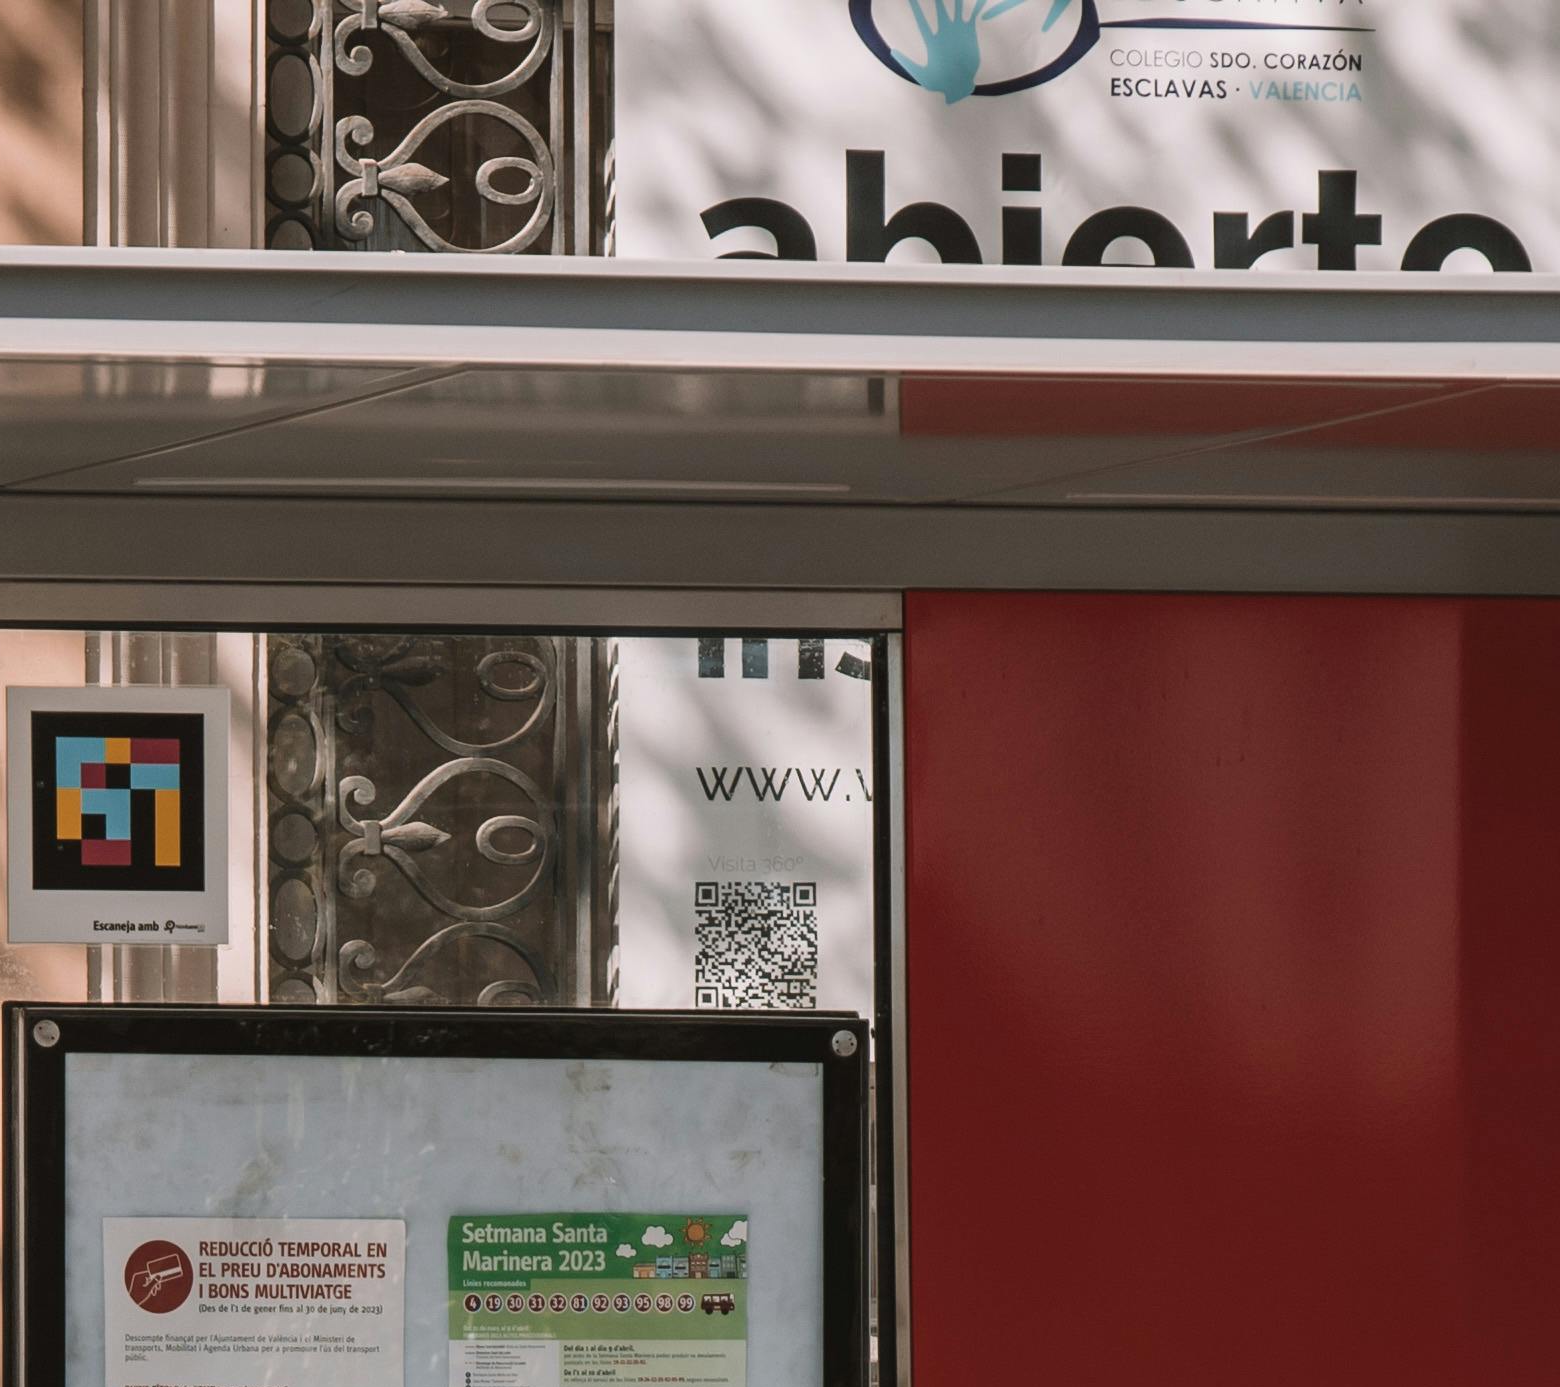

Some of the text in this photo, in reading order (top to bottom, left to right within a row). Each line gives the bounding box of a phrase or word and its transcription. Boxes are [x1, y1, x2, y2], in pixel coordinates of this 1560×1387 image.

[1110, 49, 1363, 72] COLEGIO SDO. CORAZÓN
[1110, 78, 1362, 101] ESCLAVAS VALENCIA
[708, 855, 756, 872] Visita
[93, 920, 159, 934] Escaneja amb
[462, 1222, 607, 1244] Setmana Santa
[199, 1238, 387, 1258] REDUCCIÓ TEMPORAL EN
[462, 1249, 606, 1272] Marinera 2023
[199, 1263, 386, 1279] EL PREU D'ABONAMENTS
[209, 1283, 249, 1299] BONS
[255, 1284, 352, 1299] MULTIVIATGE
[218, 1304, 228, 1312] de
[241, 1304, 251, 1312] de
[254, 1305, 276, 1315] gener
[317, 1305, 327, 1313] de
[349, 1305, 359, 1313] de
[488, 1298, 501, 1309] 19
[509, 1298, 524, 1309] 30
[552, 1298, 566, 1309] 32
[573, 1298, 587, 1309] 81
[594, 1298, 609, 1309] 92
[615, 1298, 630, 1309] 93
[636, 1298, 651, 1309] 95
[657, 1298, 672, 1309] 98
[678, 1298, 693, 1309] 99
